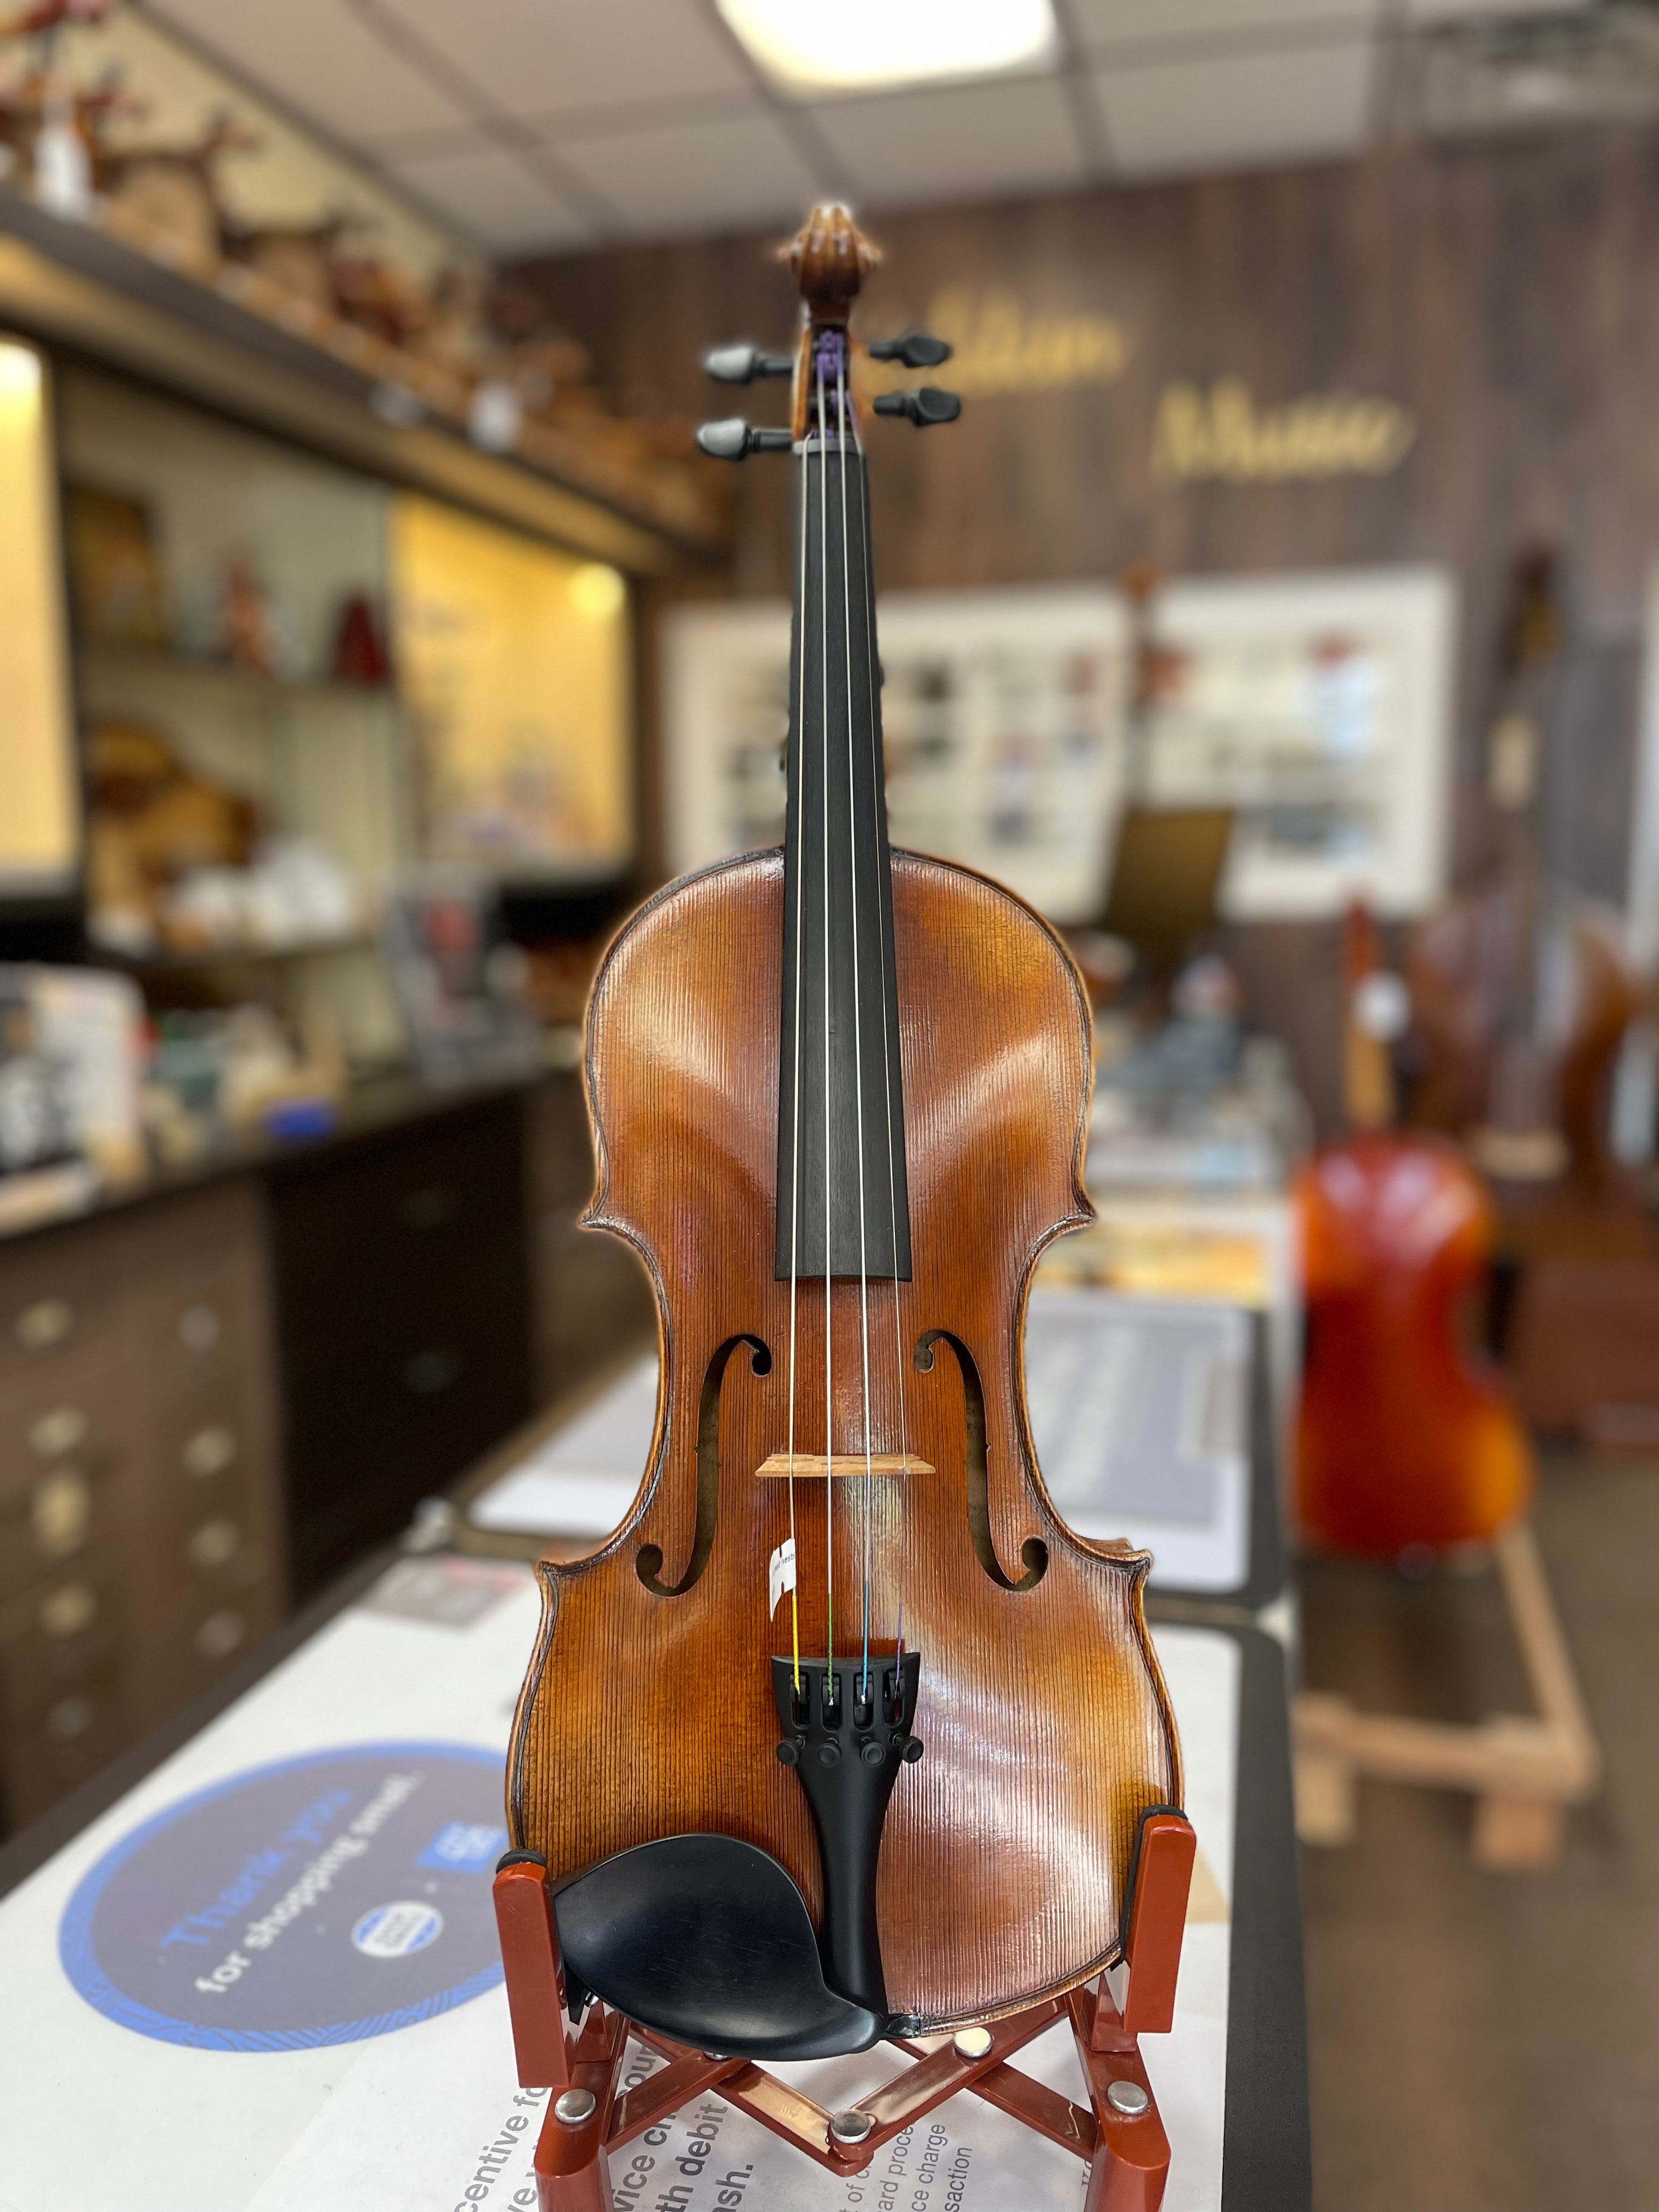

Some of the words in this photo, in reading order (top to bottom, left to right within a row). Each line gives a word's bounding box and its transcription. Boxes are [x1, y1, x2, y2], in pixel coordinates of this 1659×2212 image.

[781, 1553, 795, 1565] Nesb
[195, 1950, 251, 1993] for
[244, 1835, 368, 1950] shopping
[675, 2104, 729, 2176] debit
[916, 2124, 948, 2184] charge
[846, 2183, 865, 2203] of
[878, 2180, 899, 2212] ard
[911, 2190, 929, 2212] ce
[944, 2147, 973, 2212] saction
